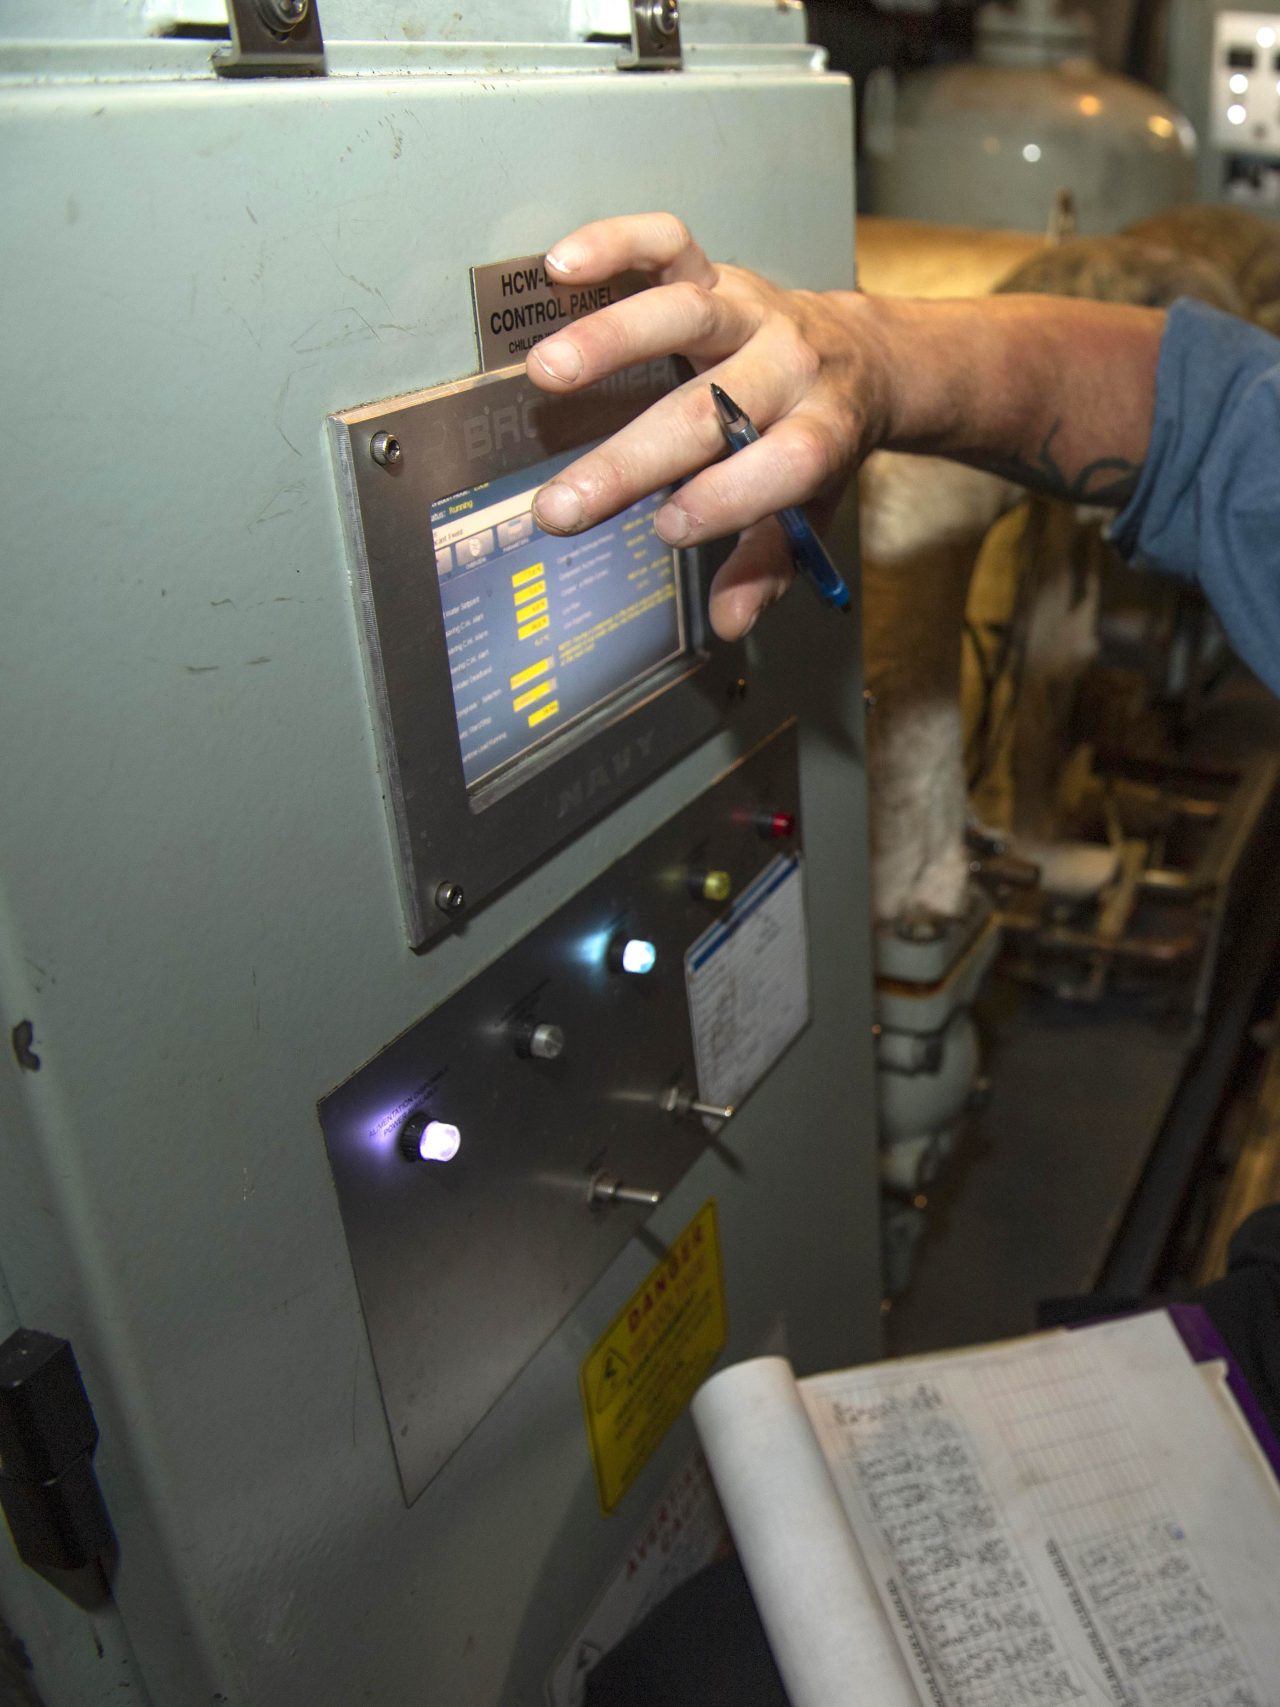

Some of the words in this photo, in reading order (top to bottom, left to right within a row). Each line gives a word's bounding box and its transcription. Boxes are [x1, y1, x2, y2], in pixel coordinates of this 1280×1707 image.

[490, 297, 567, 335] CONTROL
[569, 286, 615, 315] PANEL
[448, 500, 474, 515] Running
[627, 1224, 704, 1335] DANGER
